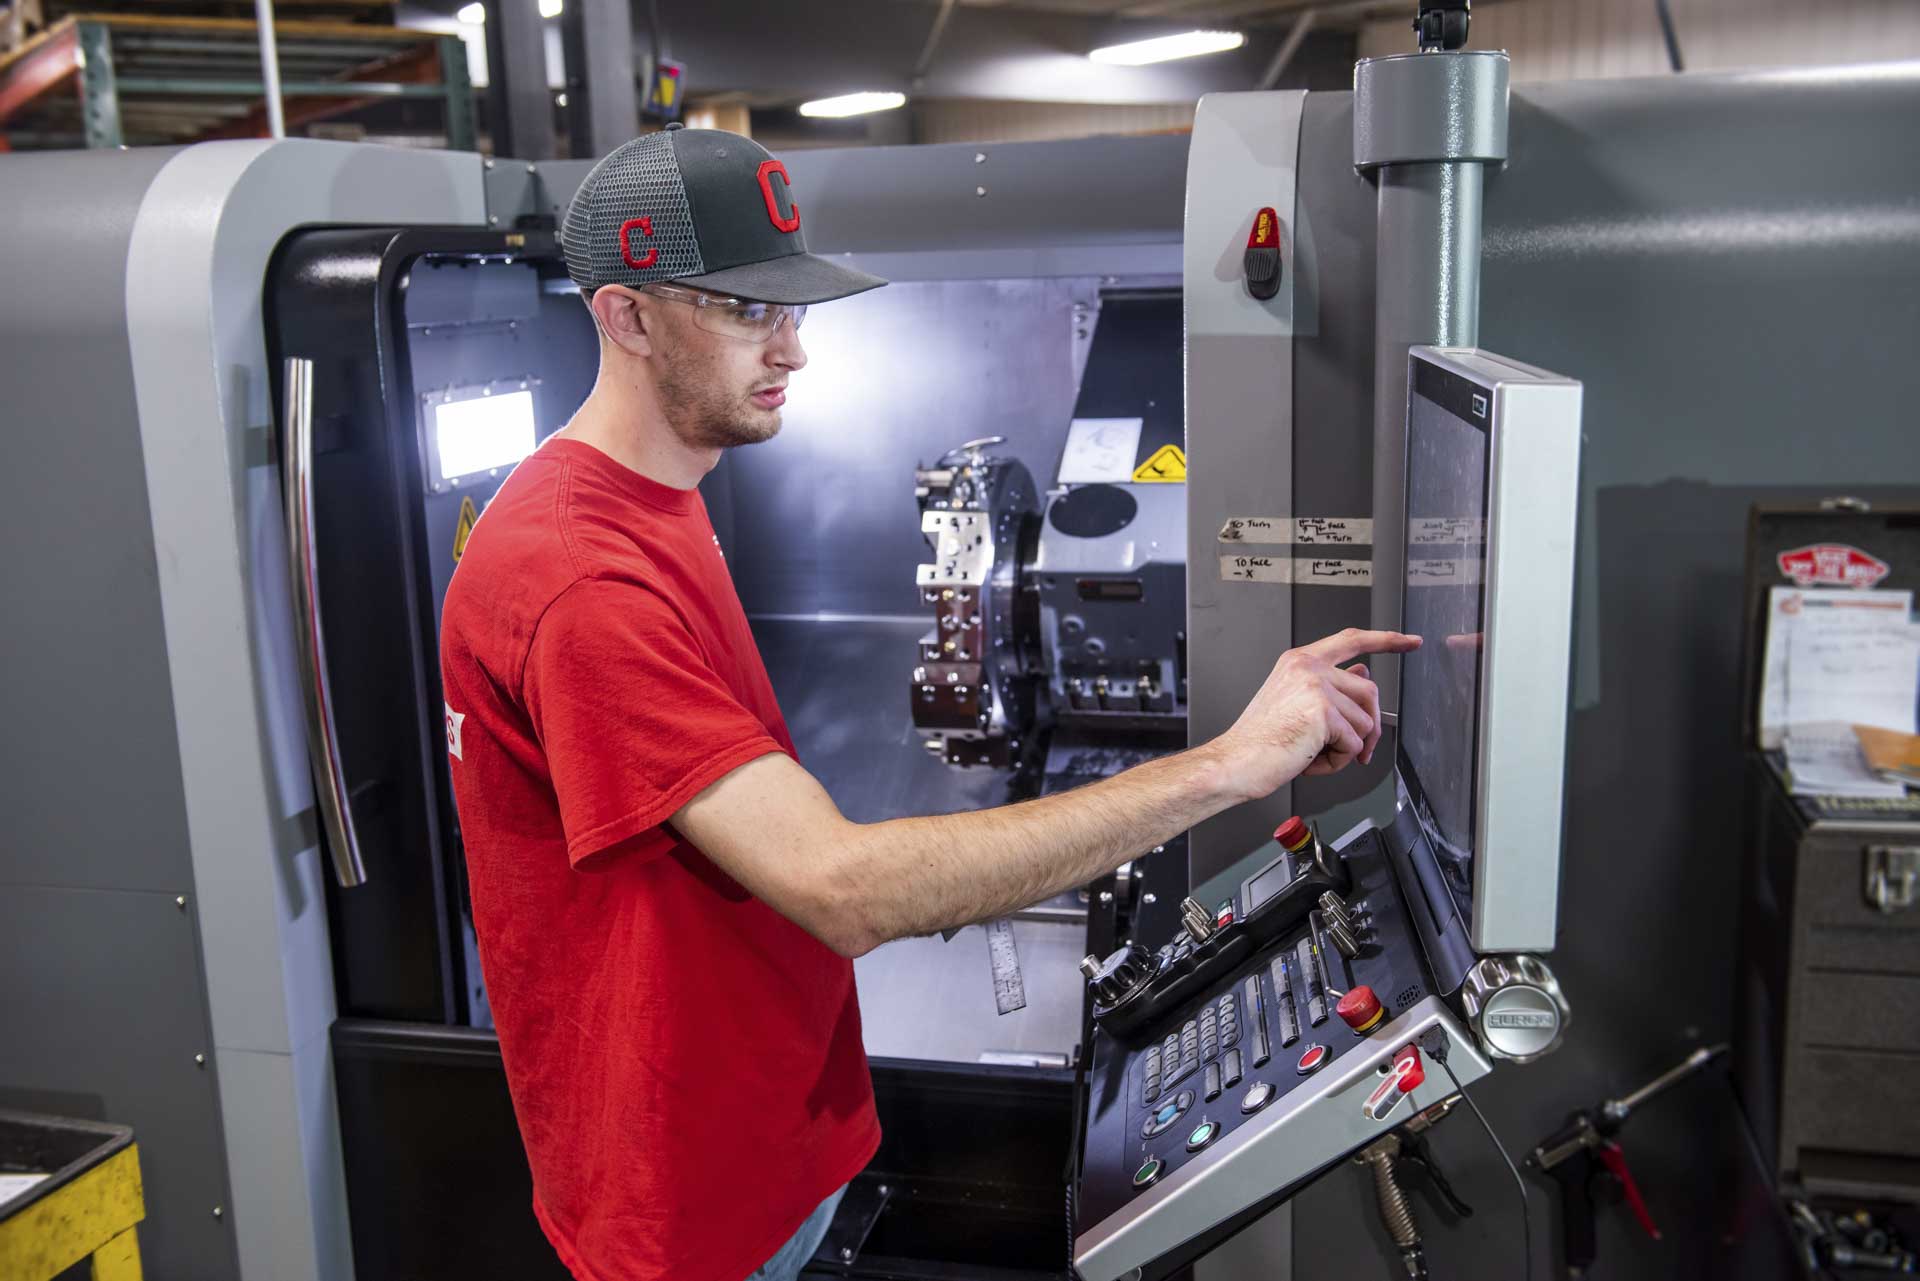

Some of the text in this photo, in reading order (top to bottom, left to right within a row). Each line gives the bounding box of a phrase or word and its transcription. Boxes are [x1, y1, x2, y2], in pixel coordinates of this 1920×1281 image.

[756, 159, 800, 233] C
[620, 217, 658, 269] C
[1247, 520, 1271, 528] Turn
[1250, 557, 1272, 567] Face
